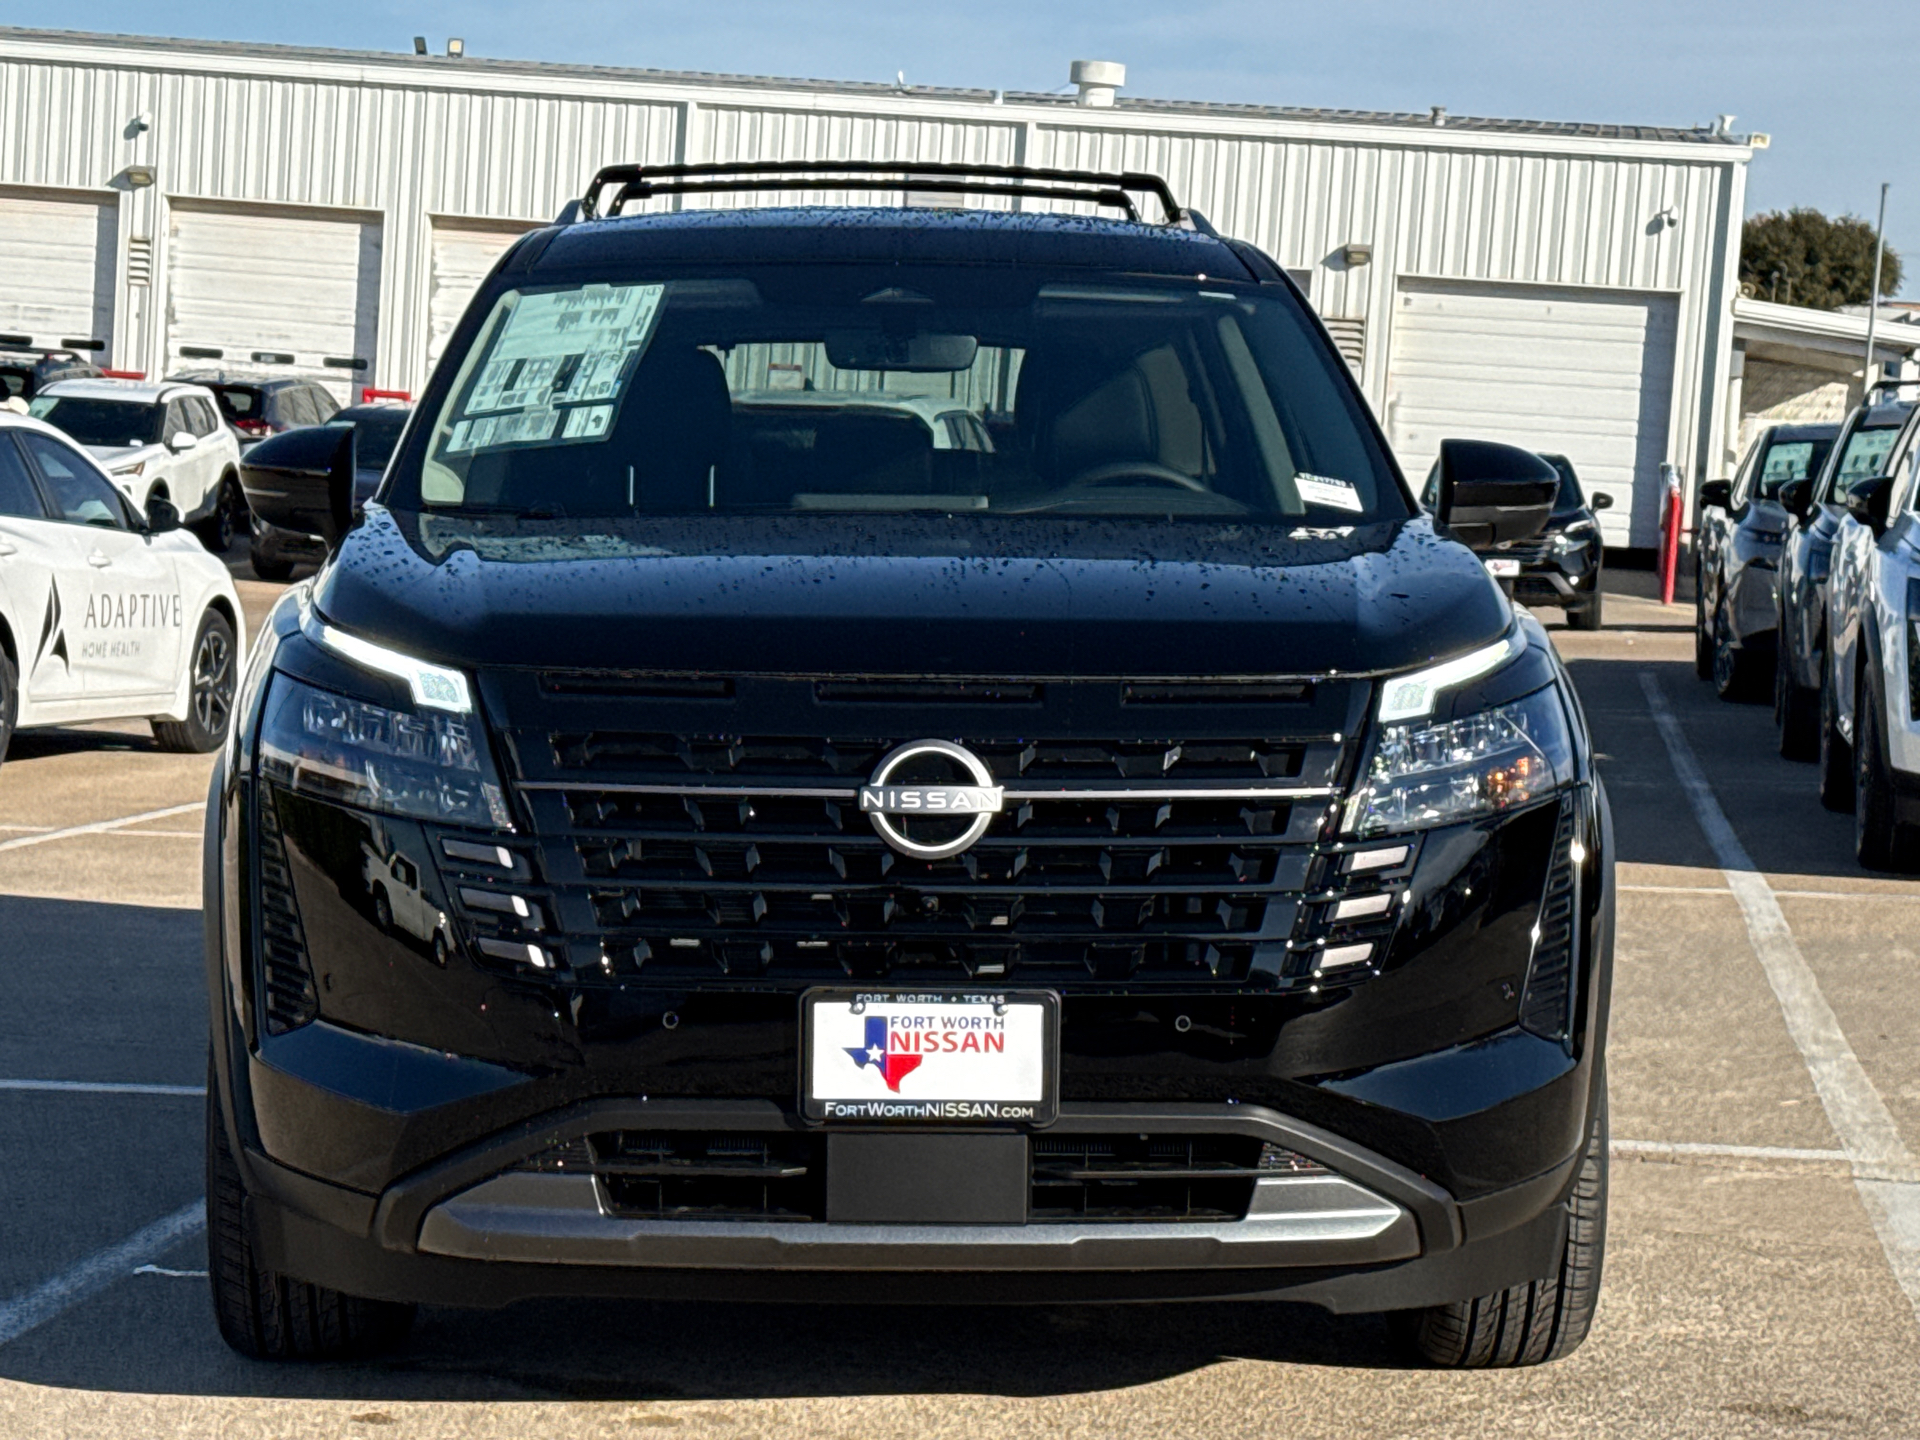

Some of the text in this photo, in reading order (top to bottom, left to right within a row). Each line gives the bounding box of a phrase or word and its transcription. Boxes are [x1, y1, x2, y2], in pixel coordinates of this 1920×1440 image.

[84, 593, 181, 628] ADAPTIVE
[82, 640, 141, 658] HOME HEALTH
[862, 790, 998, 809] NISSAN
[856, 994, 1006, 1004] FORT WORTH TEXAS
[890, 1016, 1005, 1029] FORT WORTH
[890, 1031, 1004, 1053] NISSAN
